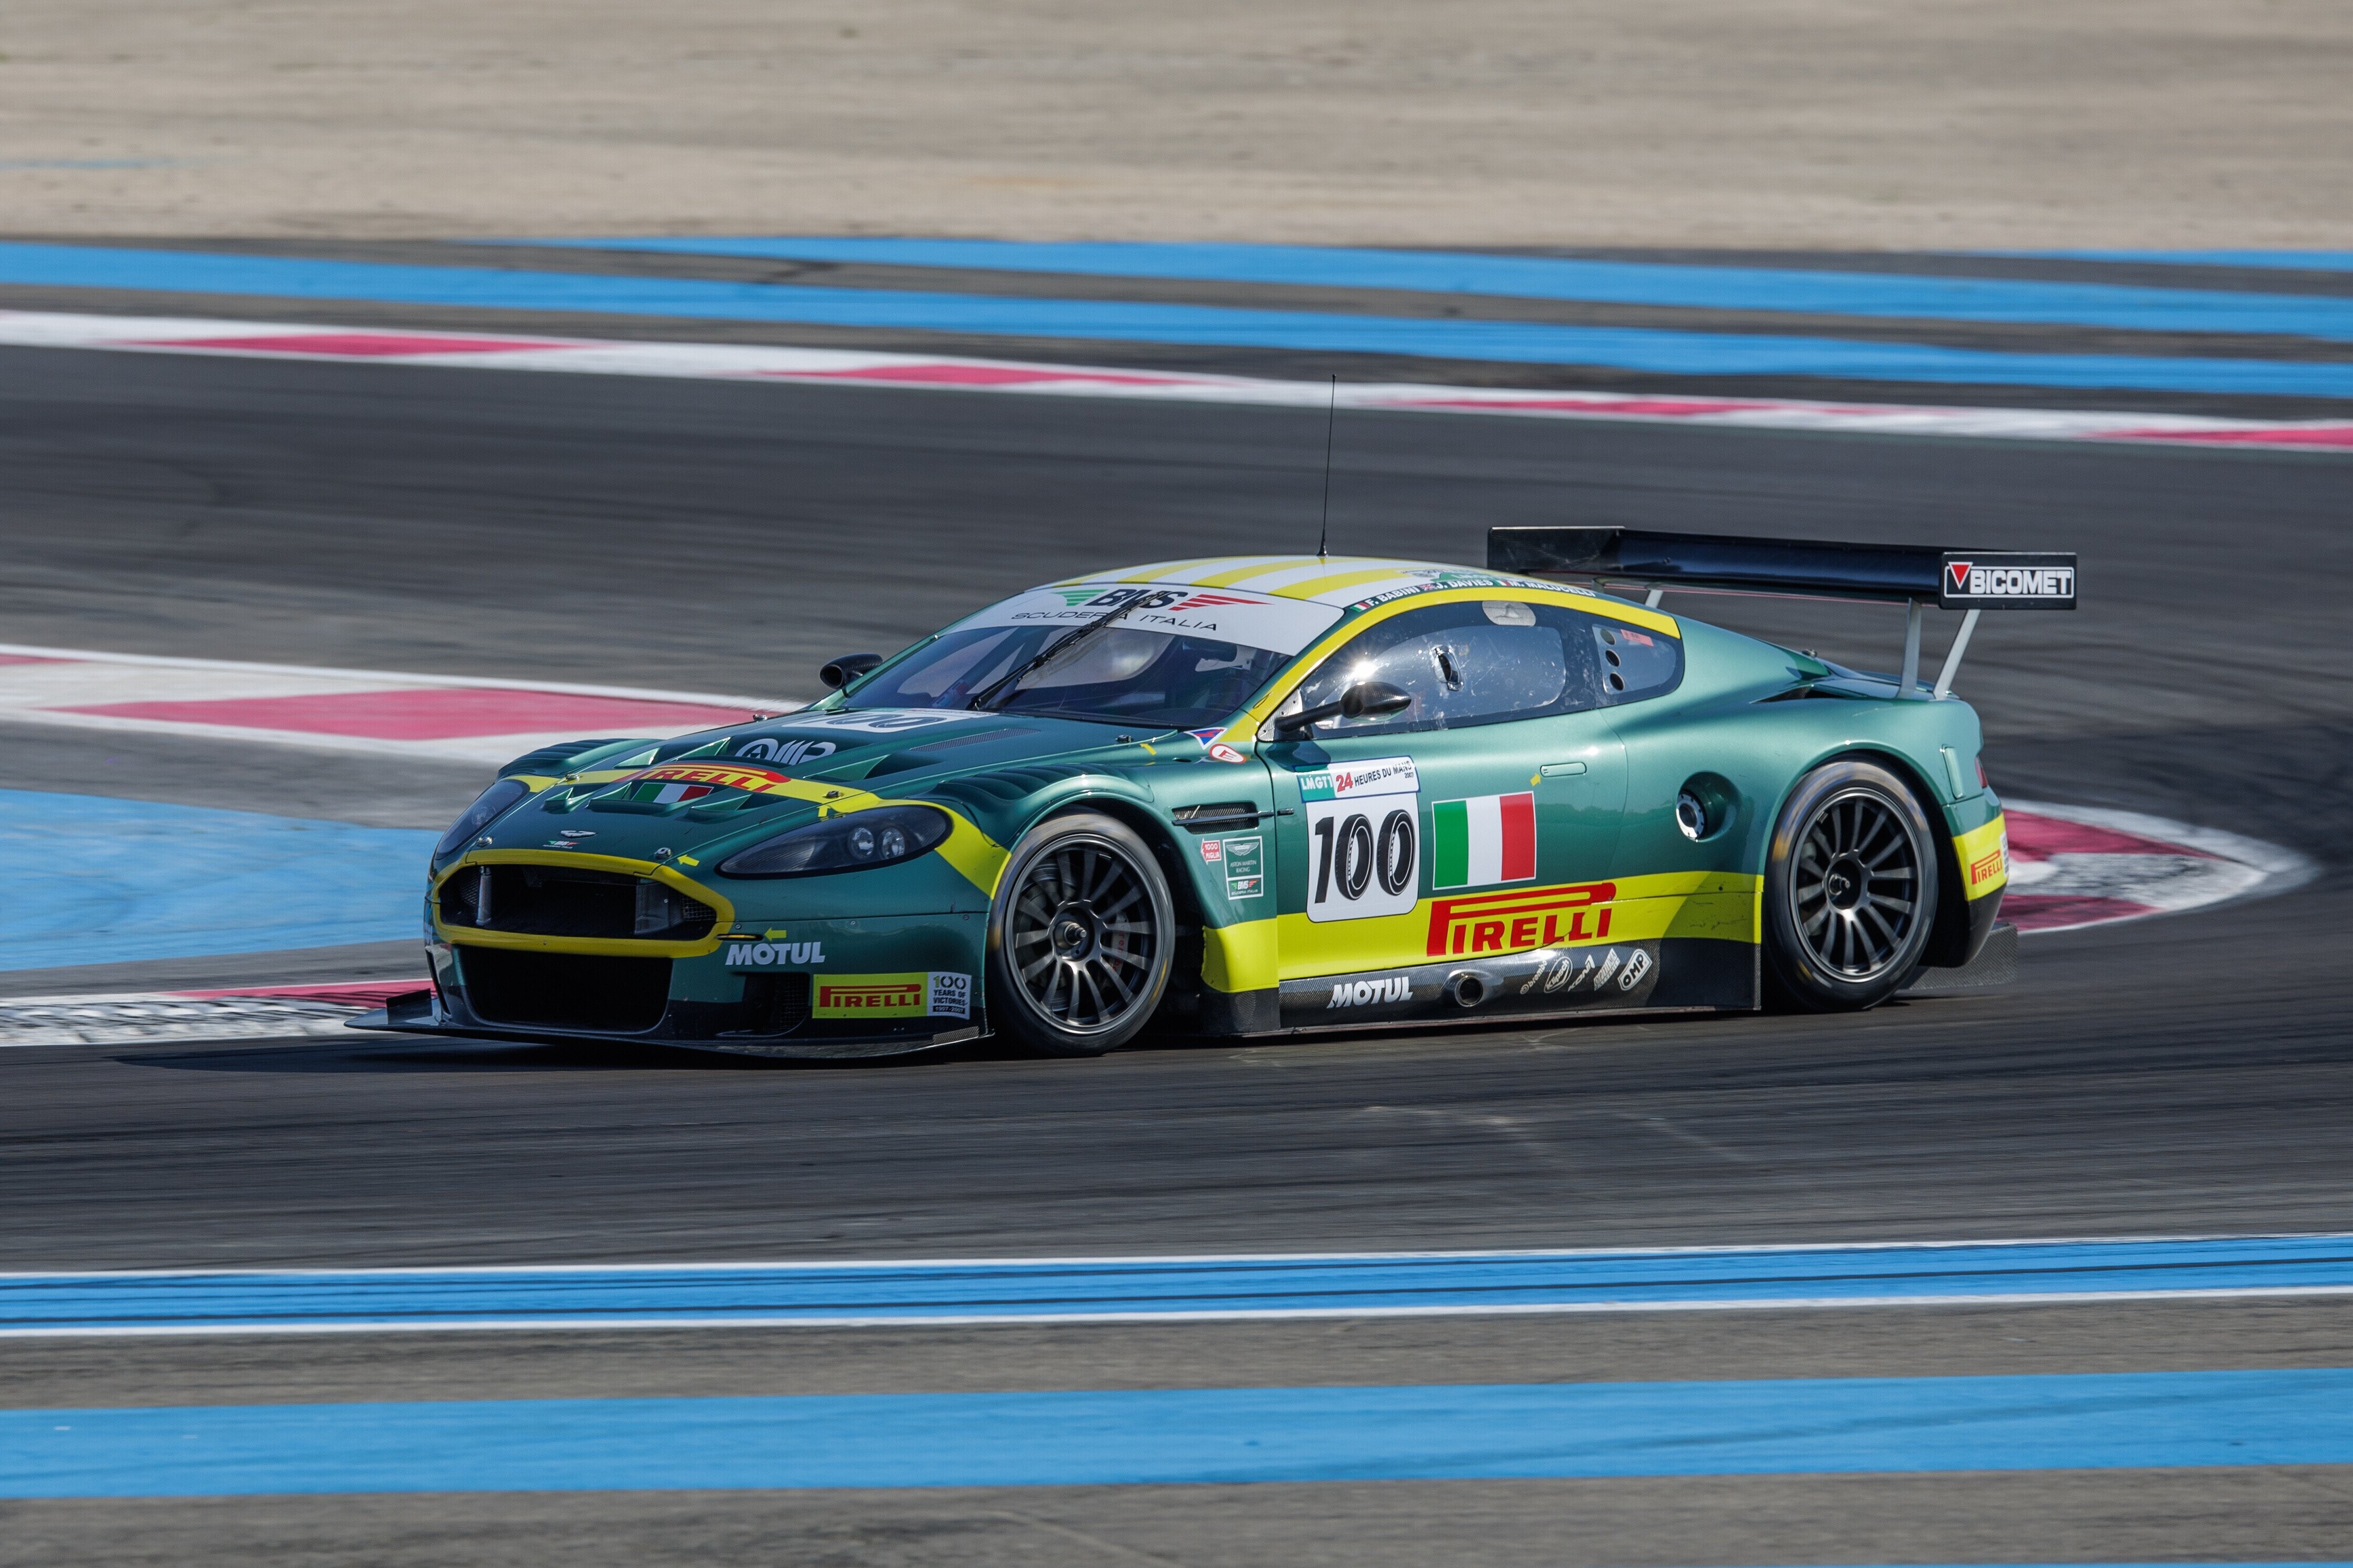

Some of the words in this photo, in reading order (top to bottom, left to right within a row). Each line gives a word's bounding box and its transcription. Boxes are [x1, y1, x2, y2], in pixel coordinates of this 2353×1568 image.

[1377, 586, 1420, 603] BABINI
[1970, 570, 2071, 594] BICOMET
[1139, 615, 1216, 631] ITALIA
[1336, 772, 1353, 792] 24
[1354, 770, 1381, 786] HEURES
[1382, 767, 1391, 778] DU
[1392, 761, 1412, 775] MANS
[1315, 809, 1416, 904] 100
[1970, 849, 2003, 885] PIRELLI
[1426, 882, 1616, 957] PIRELLI
[725, 942, 825, 965] MOTUL
[933, 975, 966, 990] 100
[1528, 959, 1547, 988] brembo
[1546, 959, 1568, 990] Klipsch
[1623, 954, 1644, 987] OMP
[819, 984, 921, 1008] PIRELLI
[1327, 976, 1413, 1009] MOTUL
